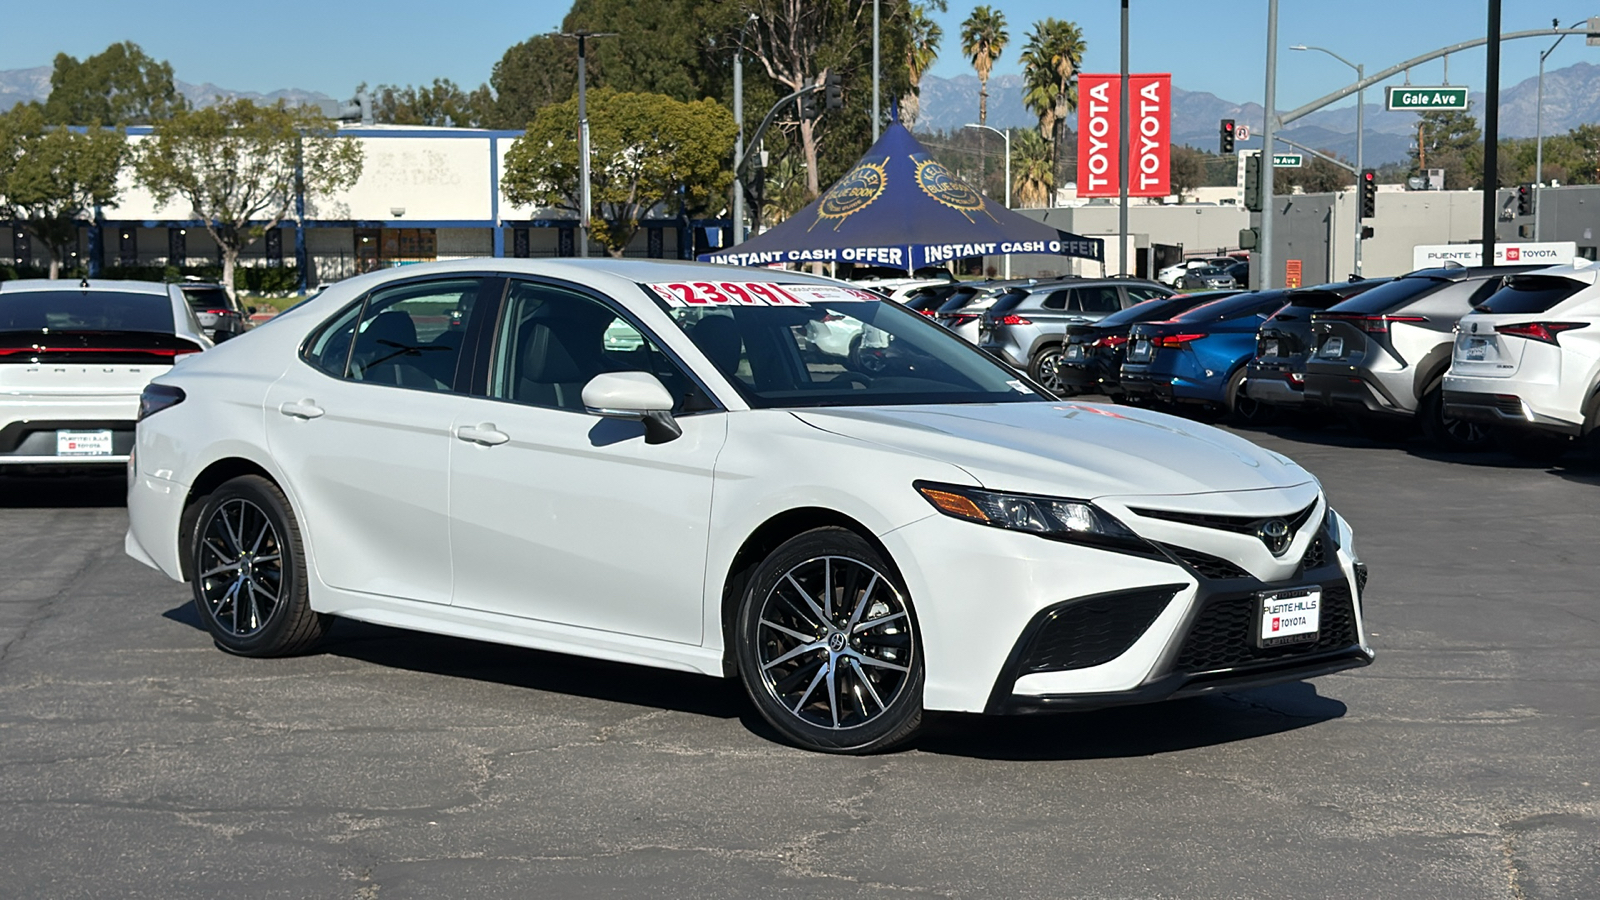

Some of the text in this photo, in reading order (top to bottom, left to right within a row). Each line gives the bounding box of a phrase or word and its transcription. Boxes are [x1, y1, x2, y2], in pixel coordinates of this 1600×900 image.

[1402, 92, 1457, 105] Gale Ave
[1088, 82, 1109, 191] TOYOTA
[1140, 81, 1160, 191] TOYOTA
[849, 187, 877, 197] BOOK
[710, 247, 902, 267] INSTANT CASH OFFER
[924, 240, 1099, 264] INSTANT CASH OFFER
[1428, 252, 1471, 260] PUENTE
[1522, 249, 1557, 258] TOYOTA
[1264, 601, 1317, 614] PUENTE HILLS
[1281, 617, 1306, 628] TOYOTA
